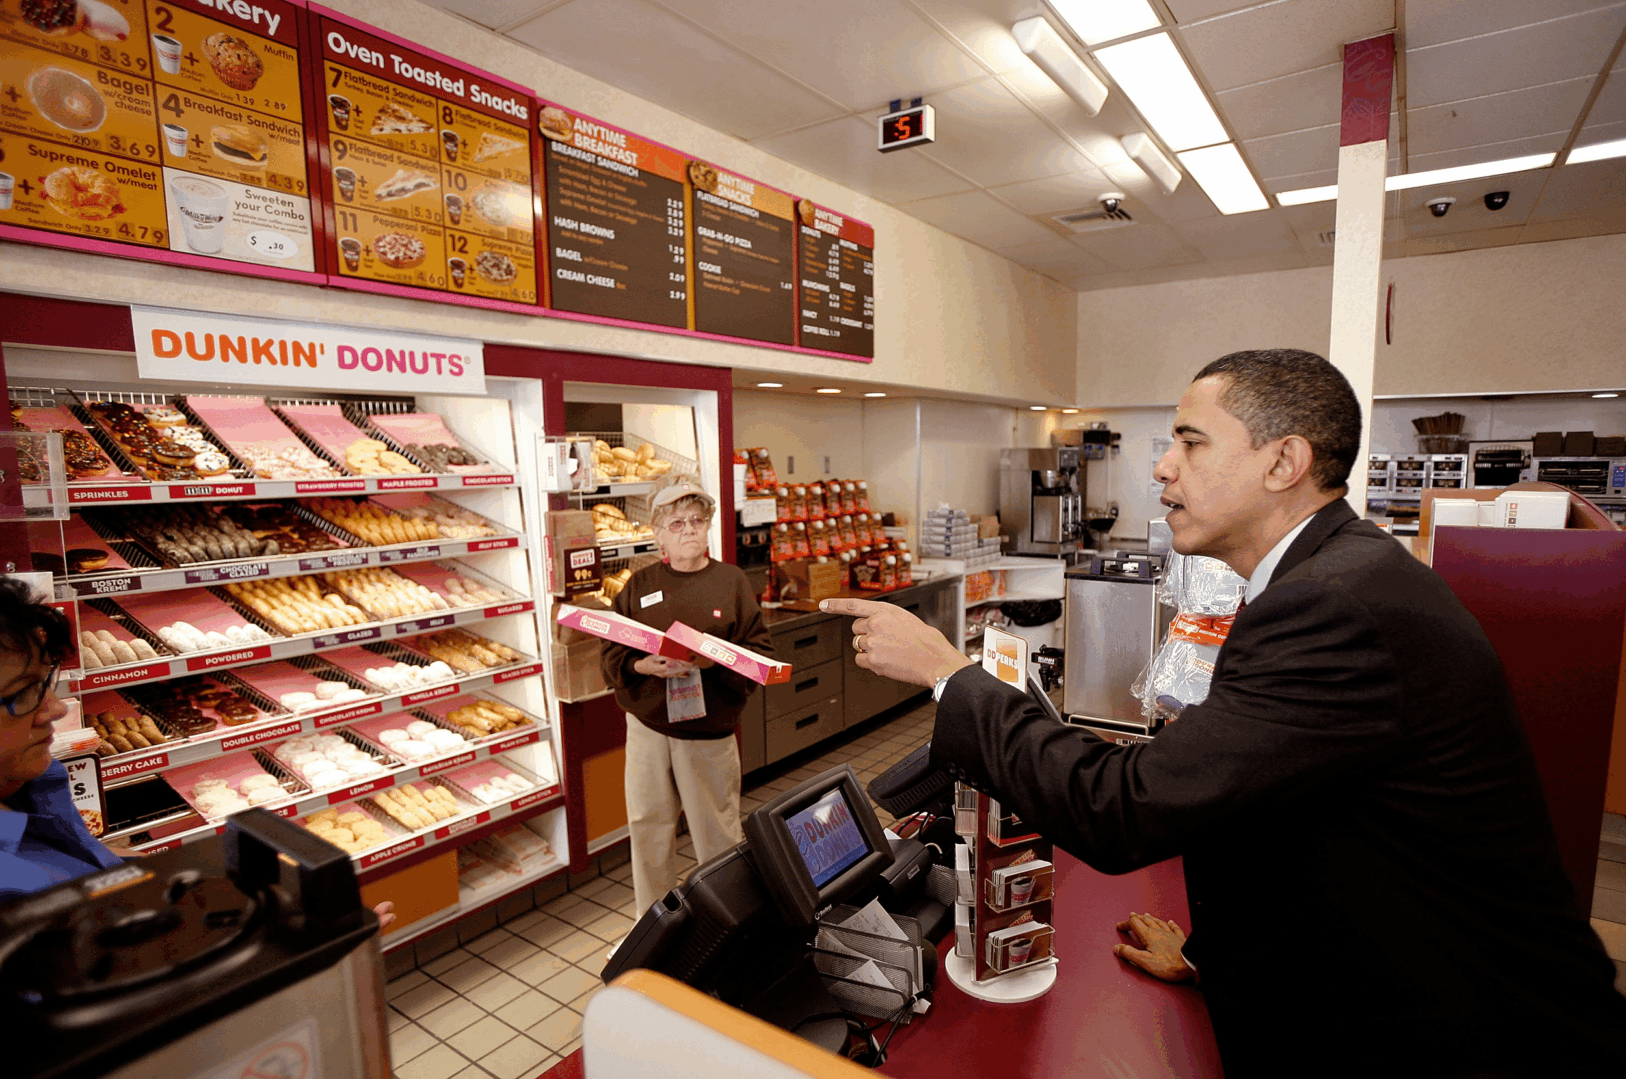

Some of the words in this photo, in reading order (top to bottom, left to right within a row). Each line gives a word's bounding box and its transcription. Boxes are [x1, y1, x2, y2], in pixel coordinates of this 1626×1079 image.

[155, 7, 175, 34] 2
[263, 44, 294, 61] Muffin
[97, 70, 150, 97] Bagel
[327, 31, 385, 69] Oven
[389, 53, 465, 97] Toasted
[469, 84, 528, 120] Snacks
[329, 66, 342, 88] 7
[344, 71, 390, 94] Flatbread
[392, 87, 435, 109] Sandwich
[114, 101, 152, 116] cheese
[162, 93, 184, 118] 4
[184, 96, 243, 122] Breakfast
[246, 115, 301, 138] Sandwich
[443, 106, 454, 125] 8
[574, 117, 627, 148] ANYTIME
[109, 134, 156, 158] 3.69
[333, 139, 348, 161] 9
[349, 143, 394, 163] Flatbread
[574, 132, 638, 166] BREAKFAST
[27, 143, 100, 170] Supreme
[104, 160, 157, 182] Omelet
[551, 141, 596, 163] BREAKFAST
[597, 156, 639, 178] SANDWICH
[117, 176, 158, 191] w/meat
[269, 174, 305, 192] 4.39
[445, 169, 467, 192] 10
[244, 189, 294, 208] Sweeten
[234, 200, 261, 214] your
[264, 205, 305, 222] Combo
[27, 217, 64, 228] Sandwich
[339, 210, 358, 233] 11
[554, 215, 579, 231] HASH
[580, 222, 615, 240] BROWNS
[118, 222, 164, 244] 4.79
[250, 235, 257, 246] $
[448, 233, 468, 254] 12
[555, 247, 582, 262] BAGEL
[556, 268, 586, 283] CREAM
[586, 274, 616, 289] CHEESE
[151, 328, 325, 369] DUNKIN'
[336, 344, 465, 377] DONUTS
[215, 486, 244, 495] DONUT
[339, 481, 366, 489] FROSTED
[382, 480, 406, 488] MAPLE
[408, 478, 435, 487] FROSTED
[73, 490, 129, 500] SPRINKLES
[220, 563, 267, 574] CHOCOLATE
[229, 568, 259, 578] GLAZED
[92, 578, 131, 589] BOSTON
[96, 584, 129, 593] KREME
[347, 630, 373, 640] GLAZED
[205, 651, 254, 665] POWDERED
[92, 669, 149, 684] CINNAMON
[319, 711, 355, 725] CHOCOLATE
[355, 706, 376, 717] KREME
[223, 734, 255, 749] DOUBLE
[255, 724, 301, 742] CHOCOLATE
[135, 756, 163, 769] CAKE
[74, 782, 87, 795] S
[350, 784, 375, 796] LEMON
[370, 850, 392, 863] APPLE
[392, 840, 417, 855] CRUMB
